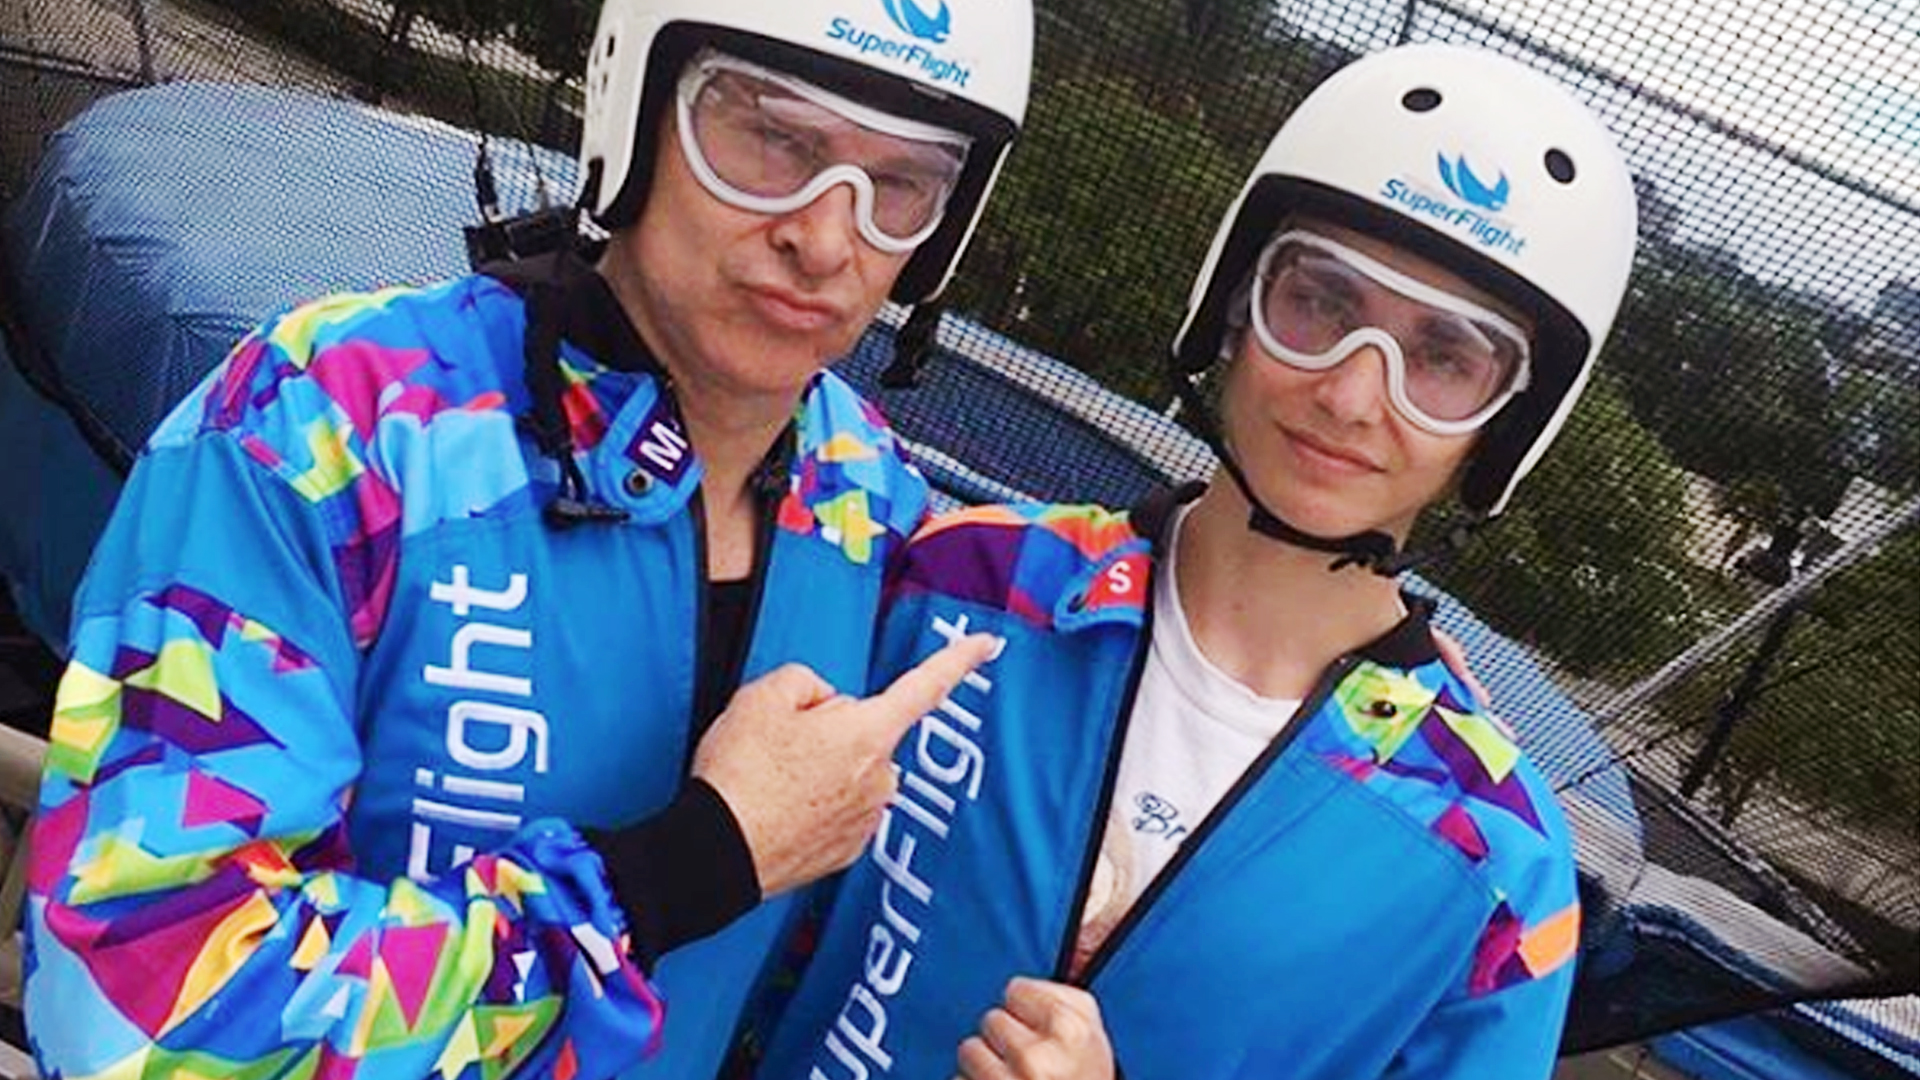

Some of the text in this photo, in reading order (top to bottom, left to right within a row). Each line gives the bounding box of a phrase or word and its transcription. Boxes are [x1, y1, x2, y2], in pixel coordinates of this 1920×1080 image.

[826, 17, 971, 87] SuperFlight
[1380, 179, 1526, 255] SuperFlight
[1107, 560, 1131, 594] S
